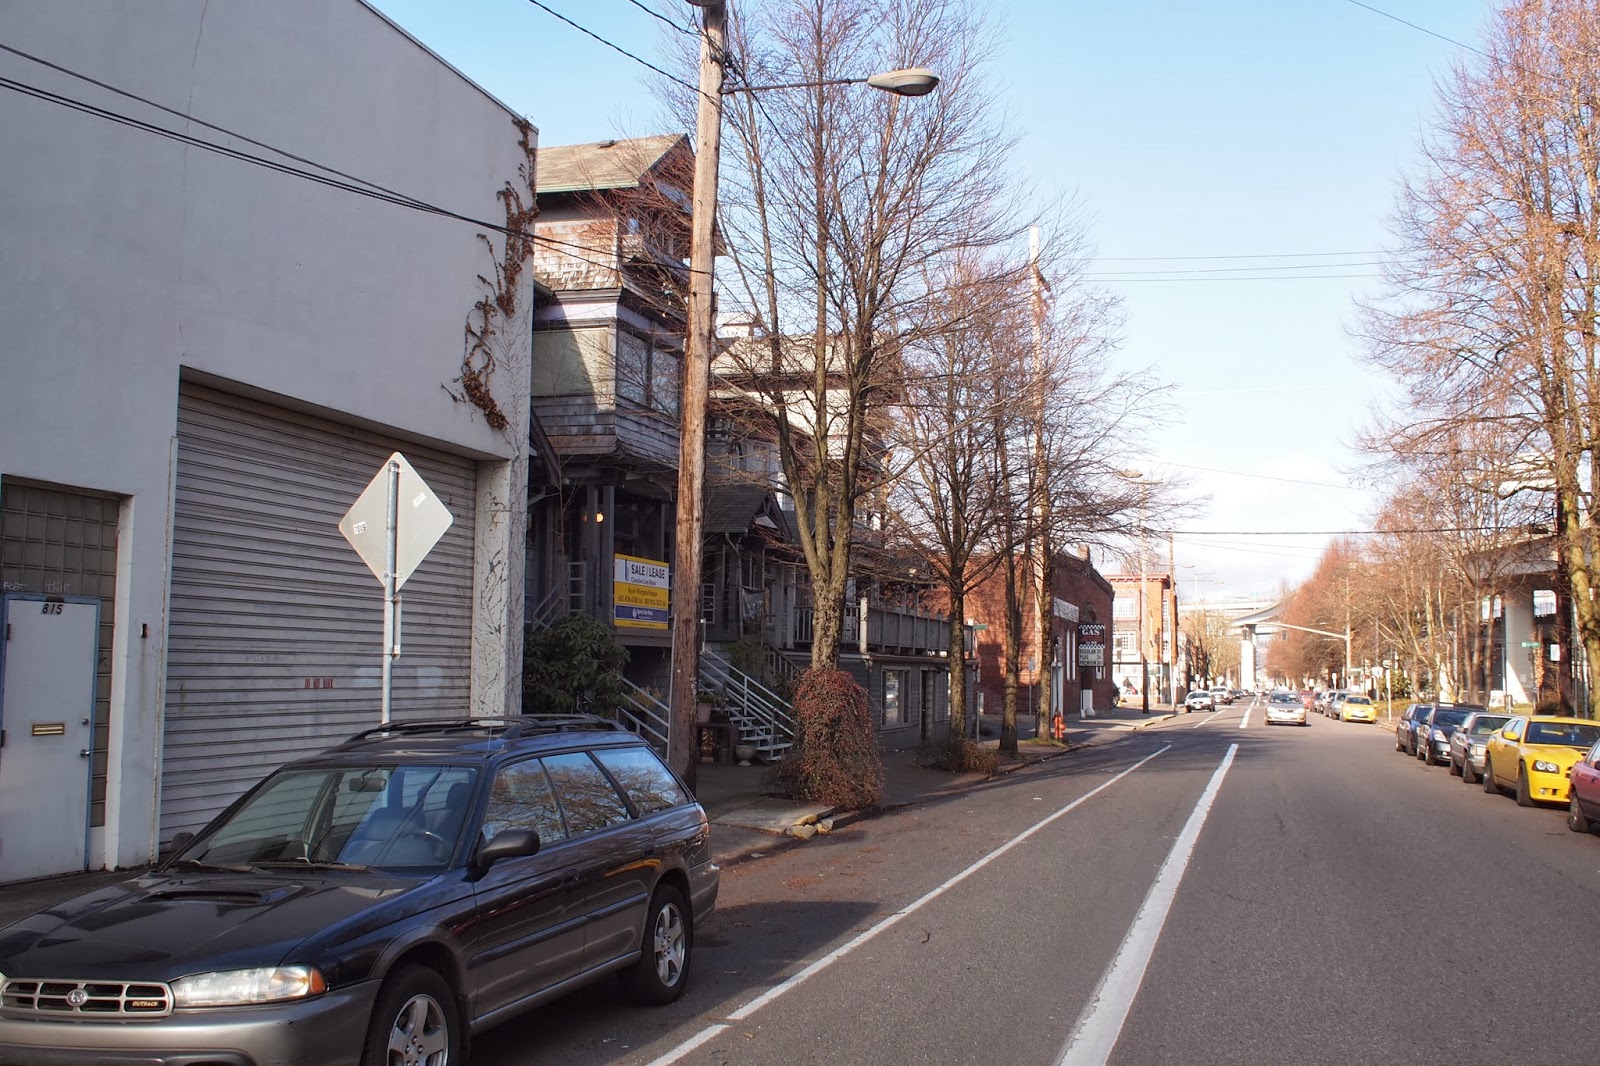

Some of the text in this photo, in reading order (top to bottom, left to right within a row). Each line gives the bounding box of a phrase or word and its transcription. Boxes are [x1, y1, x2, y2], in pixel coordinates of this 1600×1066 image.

[631, 564, 645, 576] SALE
[649, 567, 665, 579] LEASE
[42, 603, 63, 615] 815
[304, 678, 334, 689] DO NOT BLOCK
